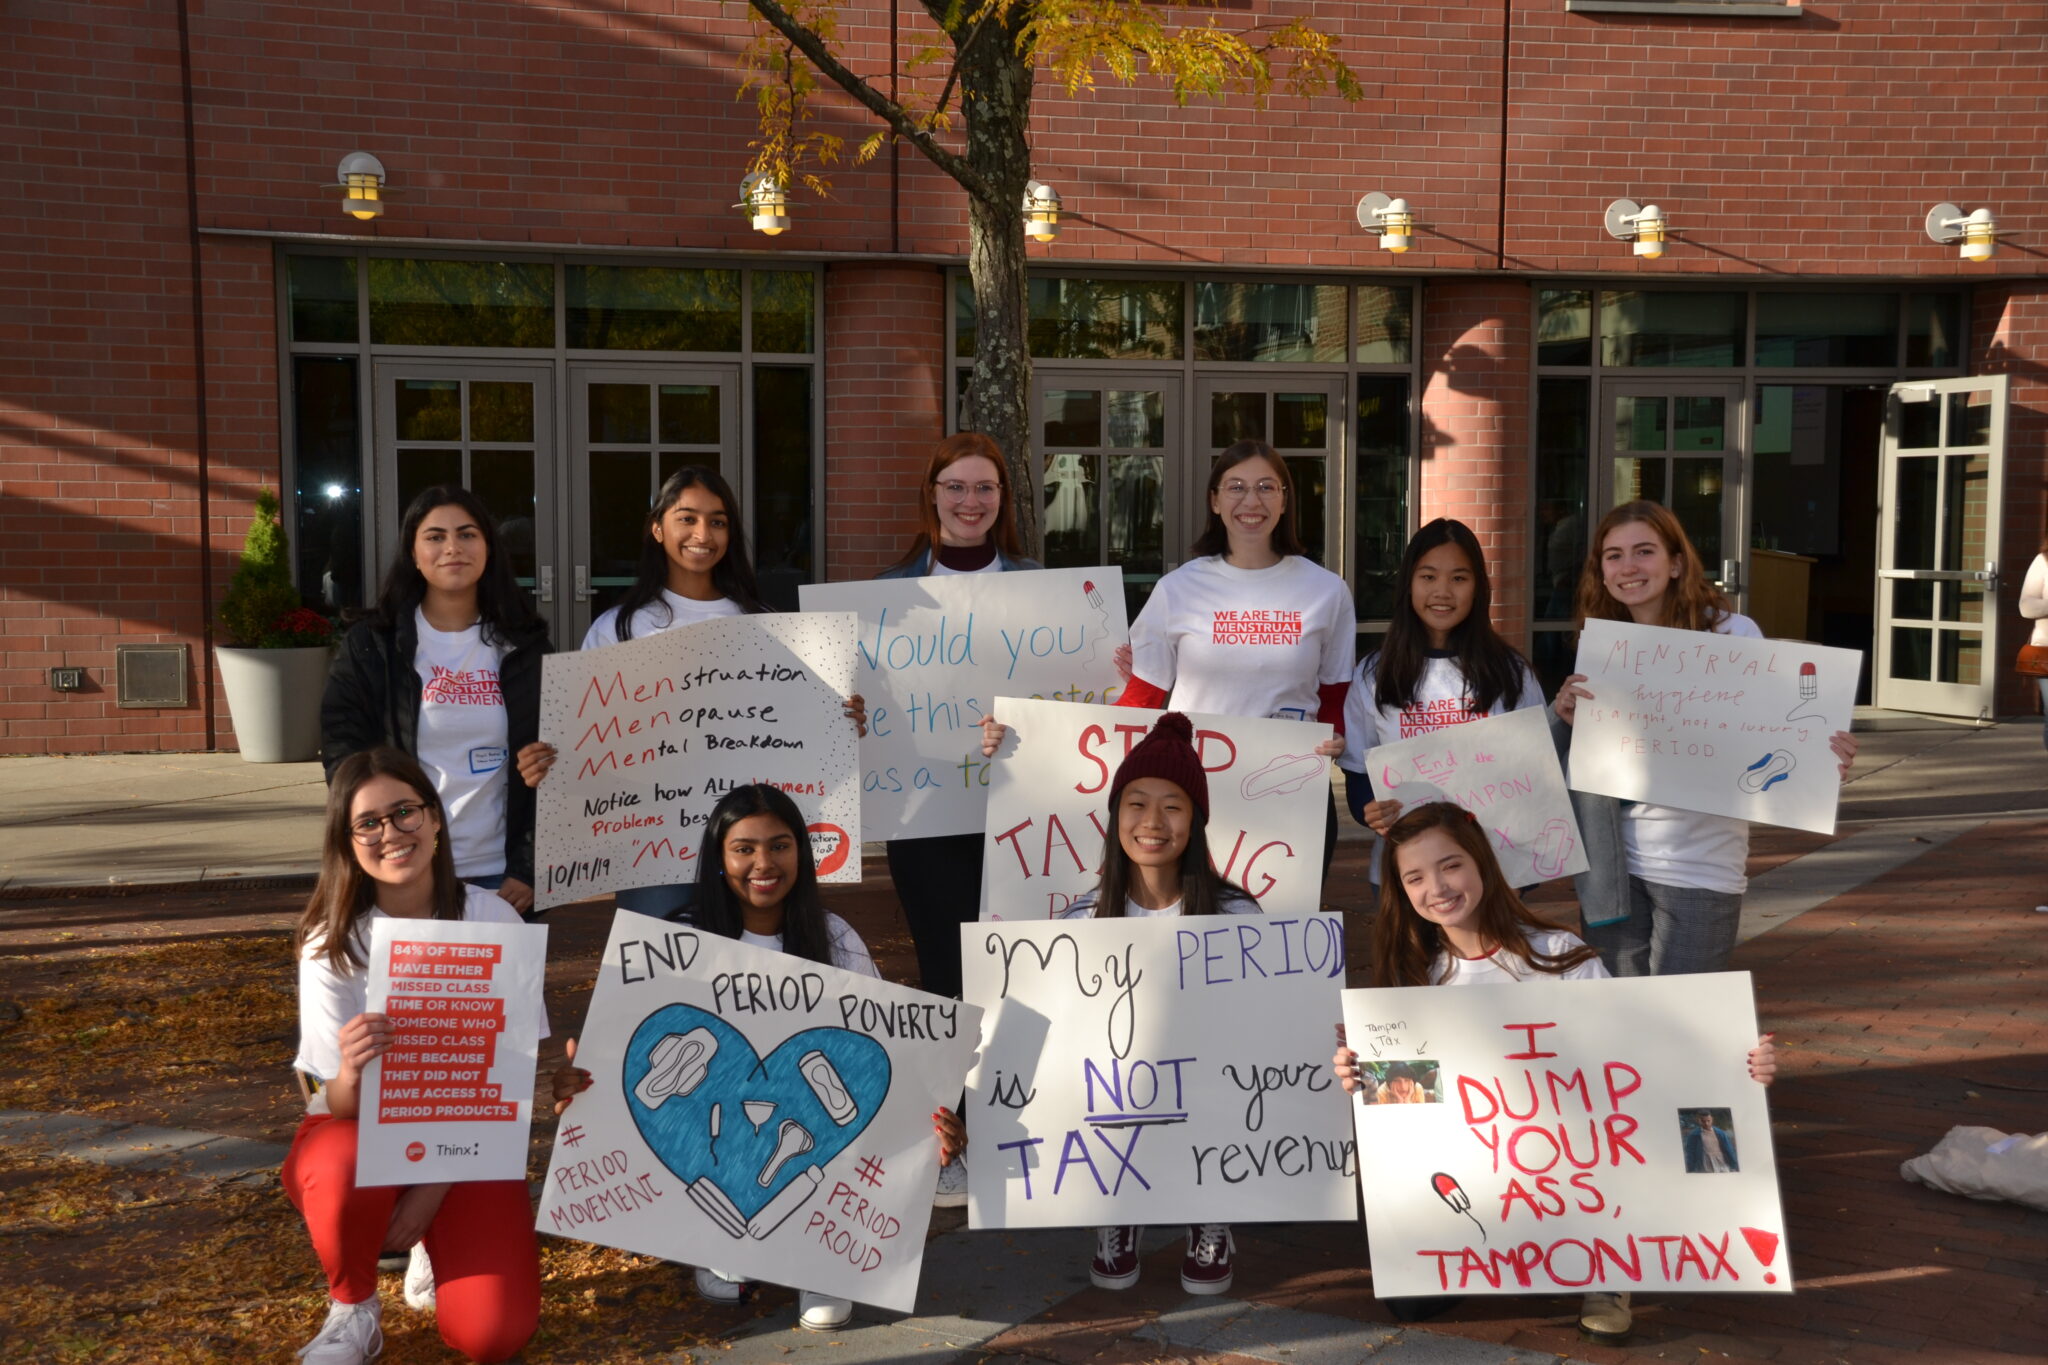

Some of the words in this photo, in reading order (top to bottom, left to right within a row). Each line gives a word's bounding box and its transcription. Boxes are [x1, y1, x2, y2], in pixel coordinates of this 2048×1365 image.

[1214, 611, 1238, 621] WE
[1241, 610, 1270, 621] ARE
[1273, 610, 1302, 622] THE
[1215, 622, 1300, 633] MENSTRUAL
[1001, 624, 1085, 680] you
[1212, 633, 1302, 646] MOVEMENT
[1602, 640, 1776, 675] MENSTRUAL
[430, 679, 501, 693] MENSTRUA
[477, 669, 499, 680] TH
[422, 690, 505, 706] MOVEMEN
[577, 663, 807, 718] Menstruation
[1632, 684, 1744, 714] hygiene
[906, 692, 985, 734] this
[1427, 698, 1456, 711] ARE
[575, 704, 778, 751] Menopause
[1612, 710, 1619, 719] a
[1683, 718, 1708, 729] not
[1741, 722, 1808, 742] luxury
[578, 739, 688, 780] Mental
[1620, 736, 1714, 757] PERIOD
[1412, 750, 1457, 774] End
[1476, 752, 1495, 763] the
[863, 767, 903, 792] as
[914, 767, 941, 789] a
[584, 791, 641, 818] Notice
[655, 783, 692, 802] how
[547, 857, 610, 893] 10/19/19
[393, 945, 423, 956] 84%
[426, 946, 446, 956] OF
[449, 947, 494, 958] TEENS
[392, 963, 430, 973] HAVE
[433, 964, 483, 975] EITHER
[391, 981, 442, 992] MISSED
[446, 983, 490, 993] CLASS
[620, 932, 699, 985] END
[711, 973, 824, 1015] PERIOD
[838, 994, 958, 1041] POVERTY
[985, 932, 1142, 1060] My
[1177, 917, 1344, 990] PERIOD
[390, 999, 423, 1010] TIME
[426, 1000, 446, 1010] OR
[451, 1001, 495, 1011] KNOW
[388, 1017, 458, 1028] SOMEONE
[462, 1019, 496, 1029] WHO
[1365, 1020, 1407, 1034] Tampon
[441, 1036, 485, 1046] CLASS
[1375, 1035, 1401, 1047] Tax
[1503, 1022, 1557, 1060] I
[386, 1053, 418, 1063] TIME
[421, 1053, 485, 1063] BECAUSE
[384, 1071, 420, 1080] THEY
[424, 1071, 448, 1080] DID
[451, 1071, 480, 1080] NOT
[383, 1089, 419, 1099] HAVE
[423, 1088, 476, 1098] ACCESS
[480, 1088, 498, 1098] TO
[988, 1070, 1037, 1109] is
[1084, 1057, 1197, 1113] NOT
[1222, 1062, 1332, 1131] your
[1457, 1060, 1641, 1125] DUMP
[382, 1106, 432, 1117] PERIOD
[435, 1105, 512, 1115] PRODUCTS.
[1470, 1114, 1647, 1176] YOUR
[554, 1150, 628, 1194] PERIOD
[998, 1125, 1150, 1200] TAX
[1192, 1135, 1355, 1185] revenue
[550, 1173, 663, 1231] MOVEMENT
[1499, 1172, 1622, 1222] ASS,
[826, 1182, 900, 1240] PERIOD
[804, 1211, 882, 1273] PROUD
